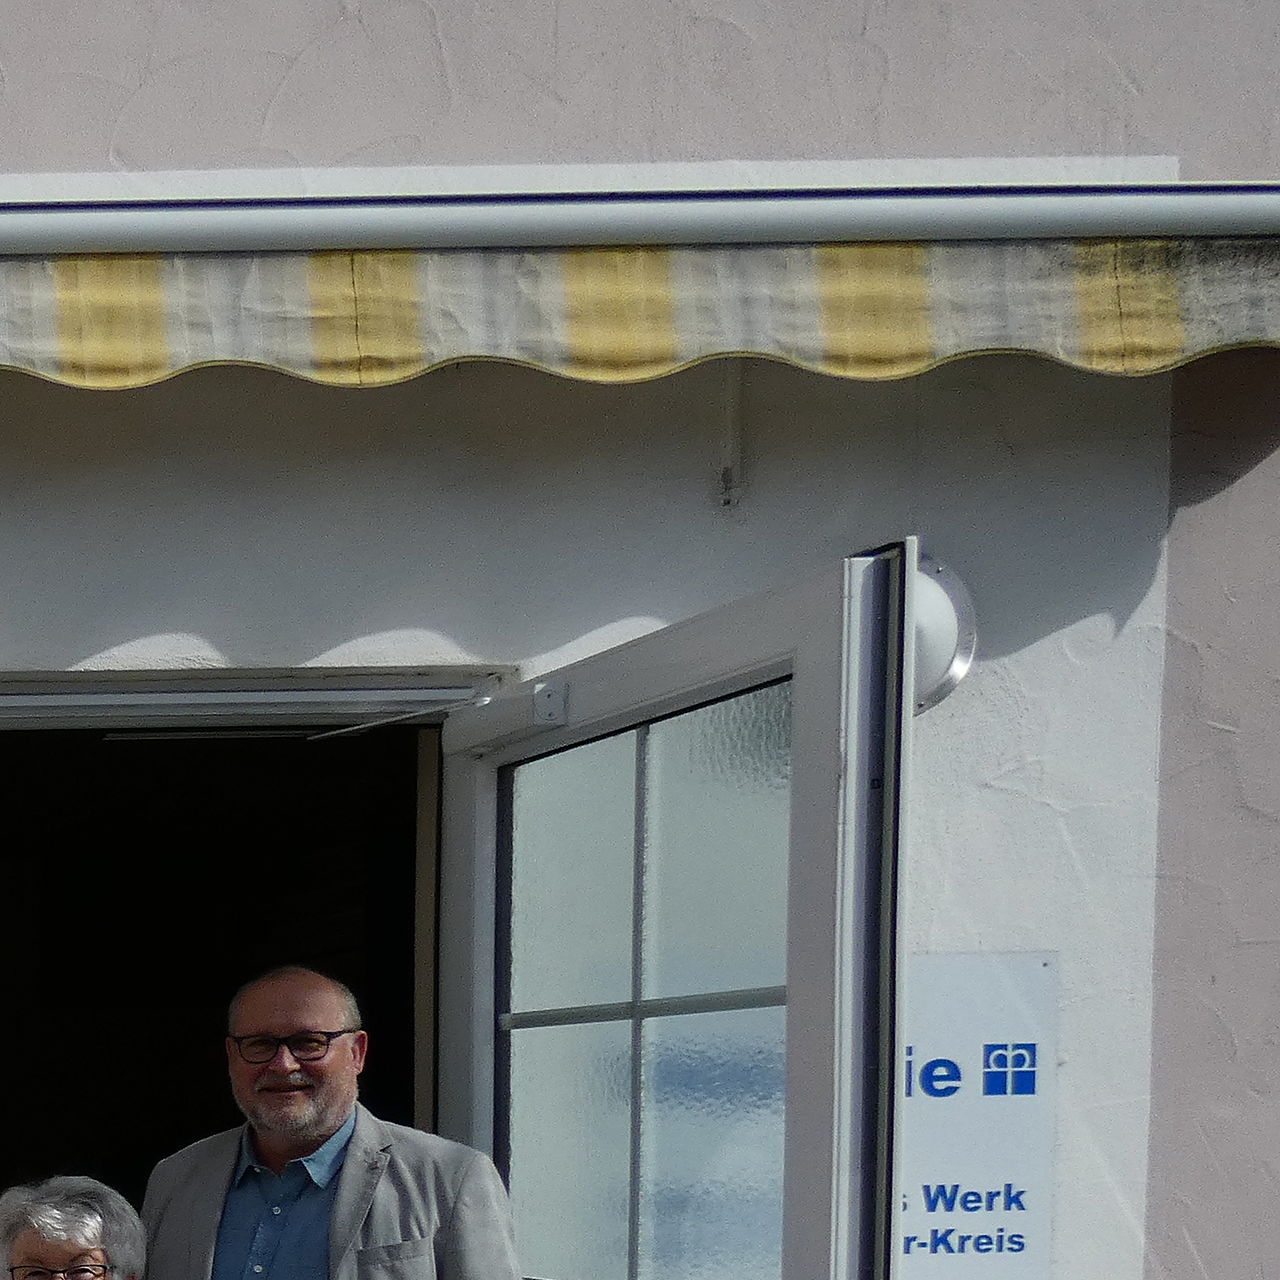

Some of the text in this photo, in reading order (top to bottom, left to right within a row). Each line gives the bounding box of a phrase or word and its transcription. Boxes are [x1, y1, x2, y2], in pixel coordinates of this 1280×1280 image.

[904, 1046, 962, 1099] ie
[922, 1183, 1027, 1213] Werk
[903, 1228, 1026, 1255] r-Kreis
